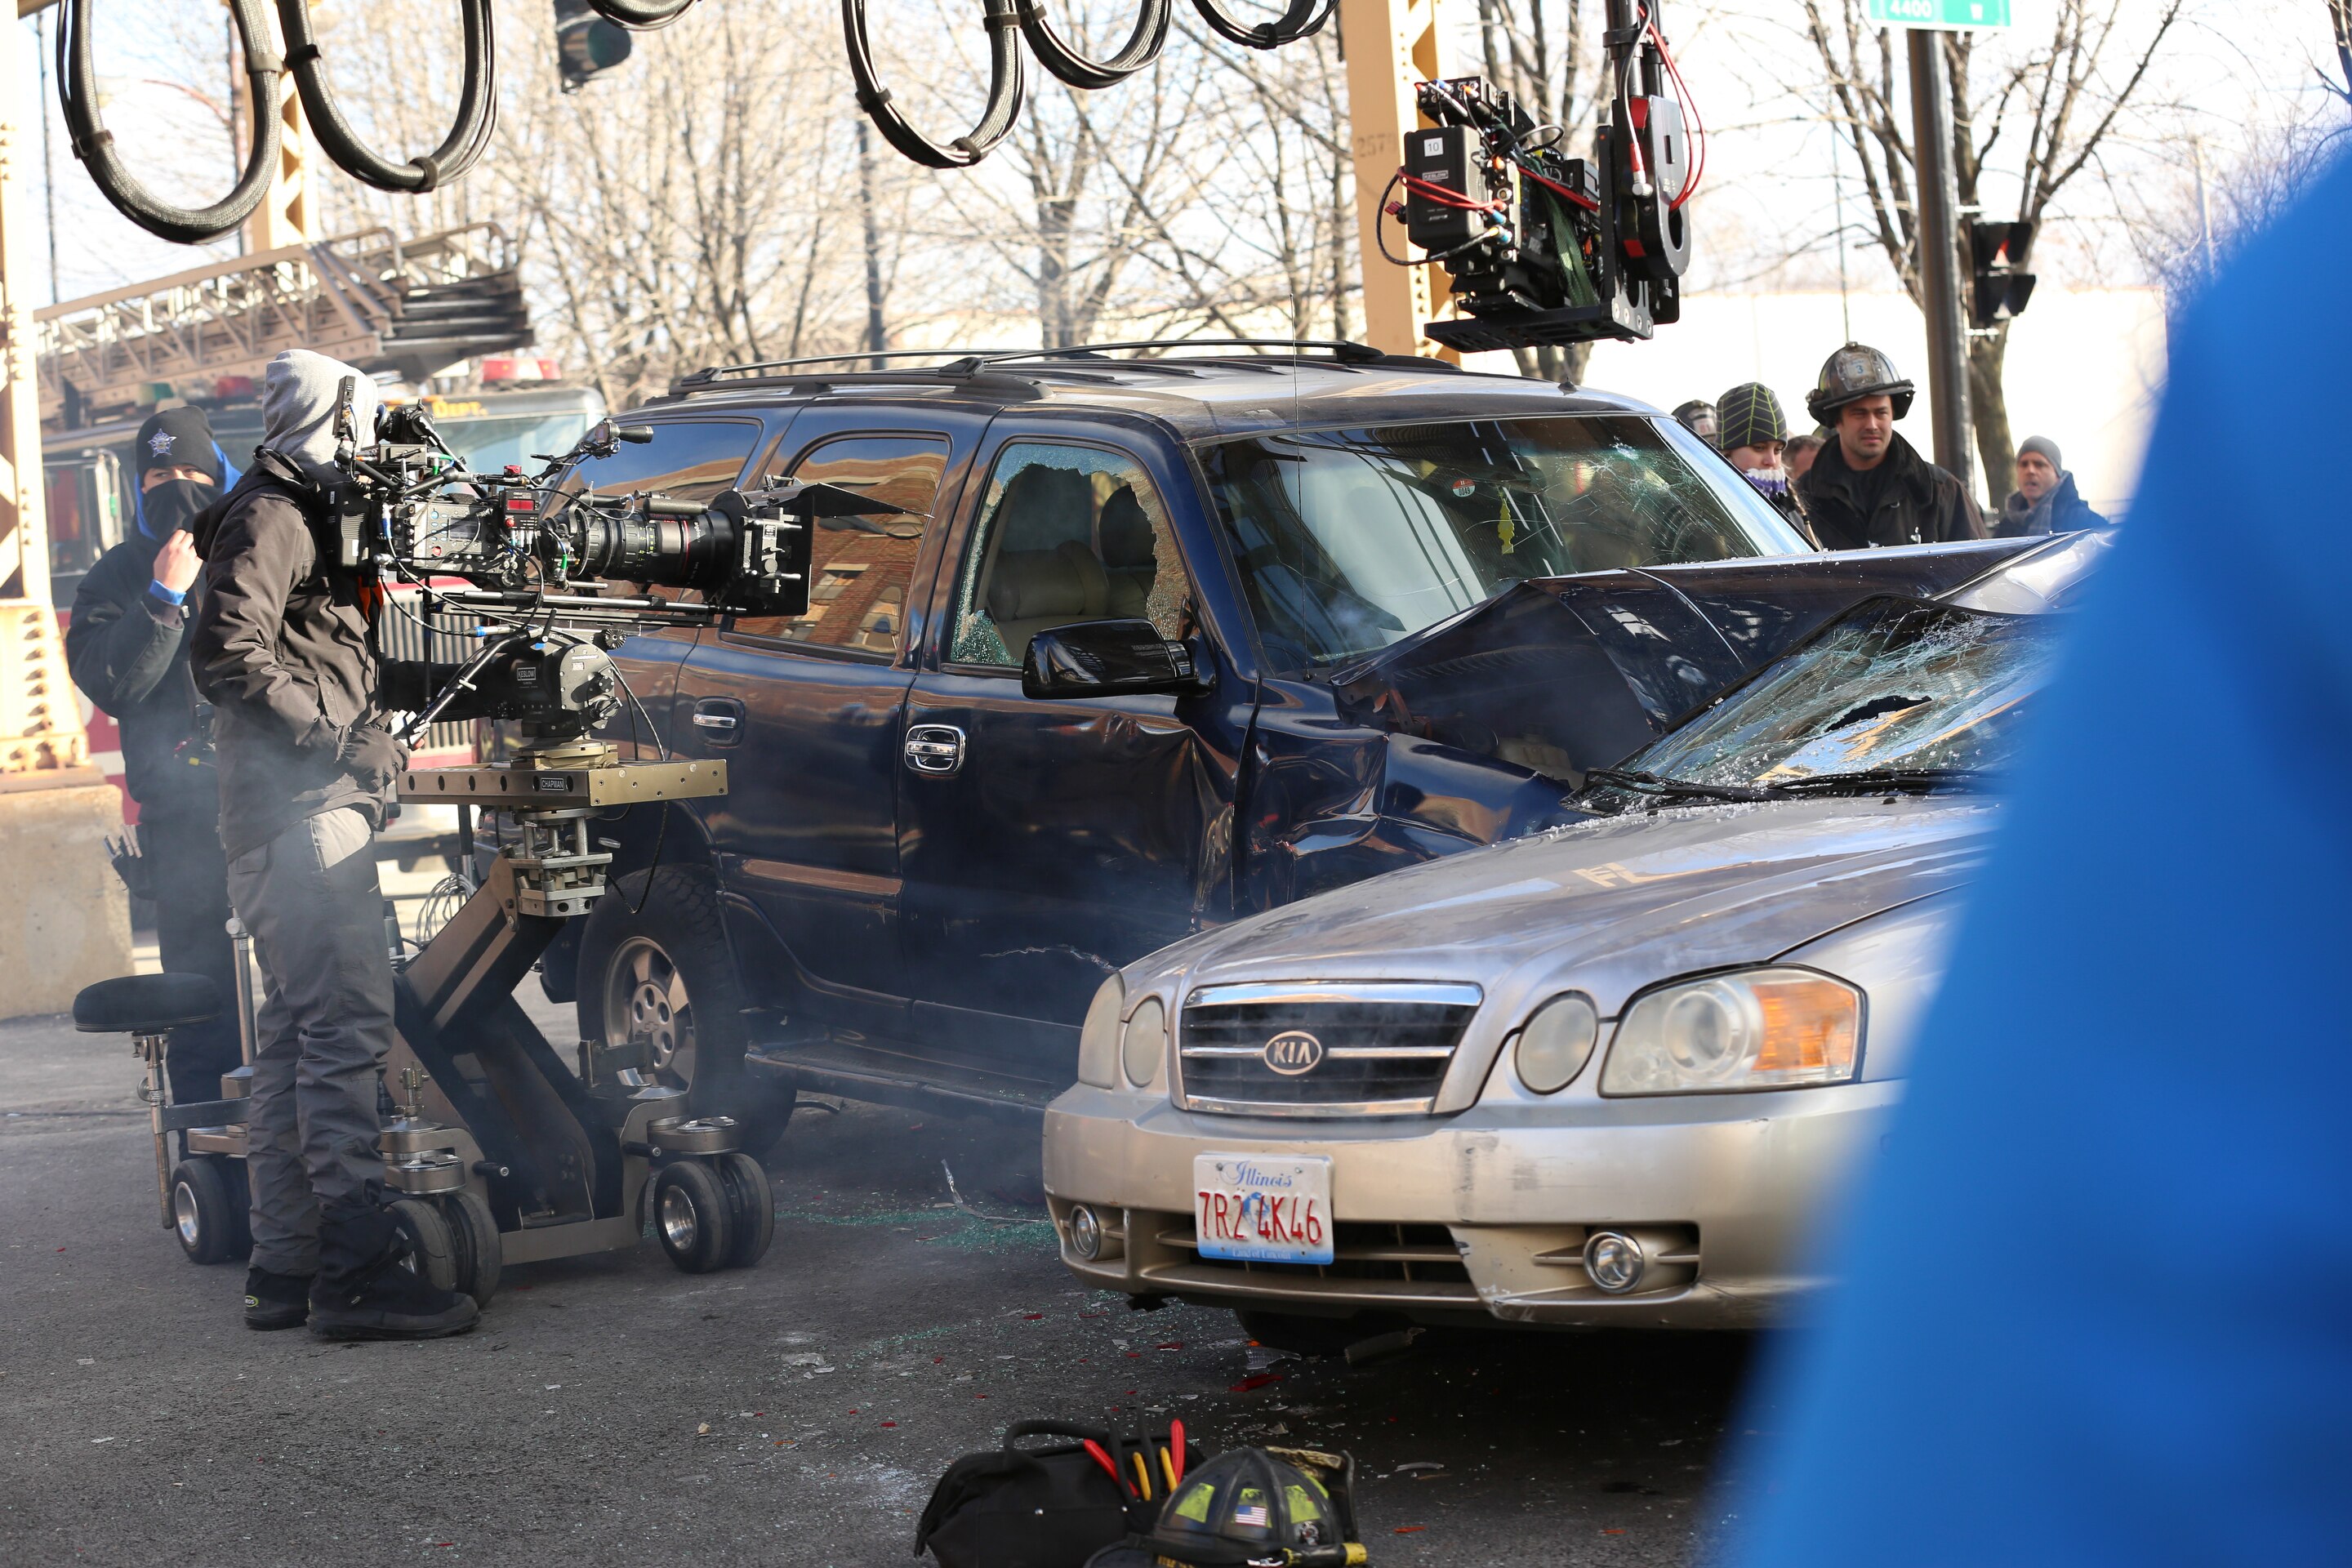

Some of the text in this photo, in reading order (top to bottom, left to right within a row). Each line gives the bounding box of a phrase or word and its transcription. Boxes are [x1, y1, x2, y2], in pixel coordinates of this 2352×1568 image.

[1890, 0, 1932, 18] 4400
[1428, 142, 1440, 152] 10
[1855, 364, 1864, 374] 3
[541, 779, 564, 789] CHAPMAN
[1274, 1041, 1312, 1063] KIA
[1221, 1160, 1293, 1187] Illinois
